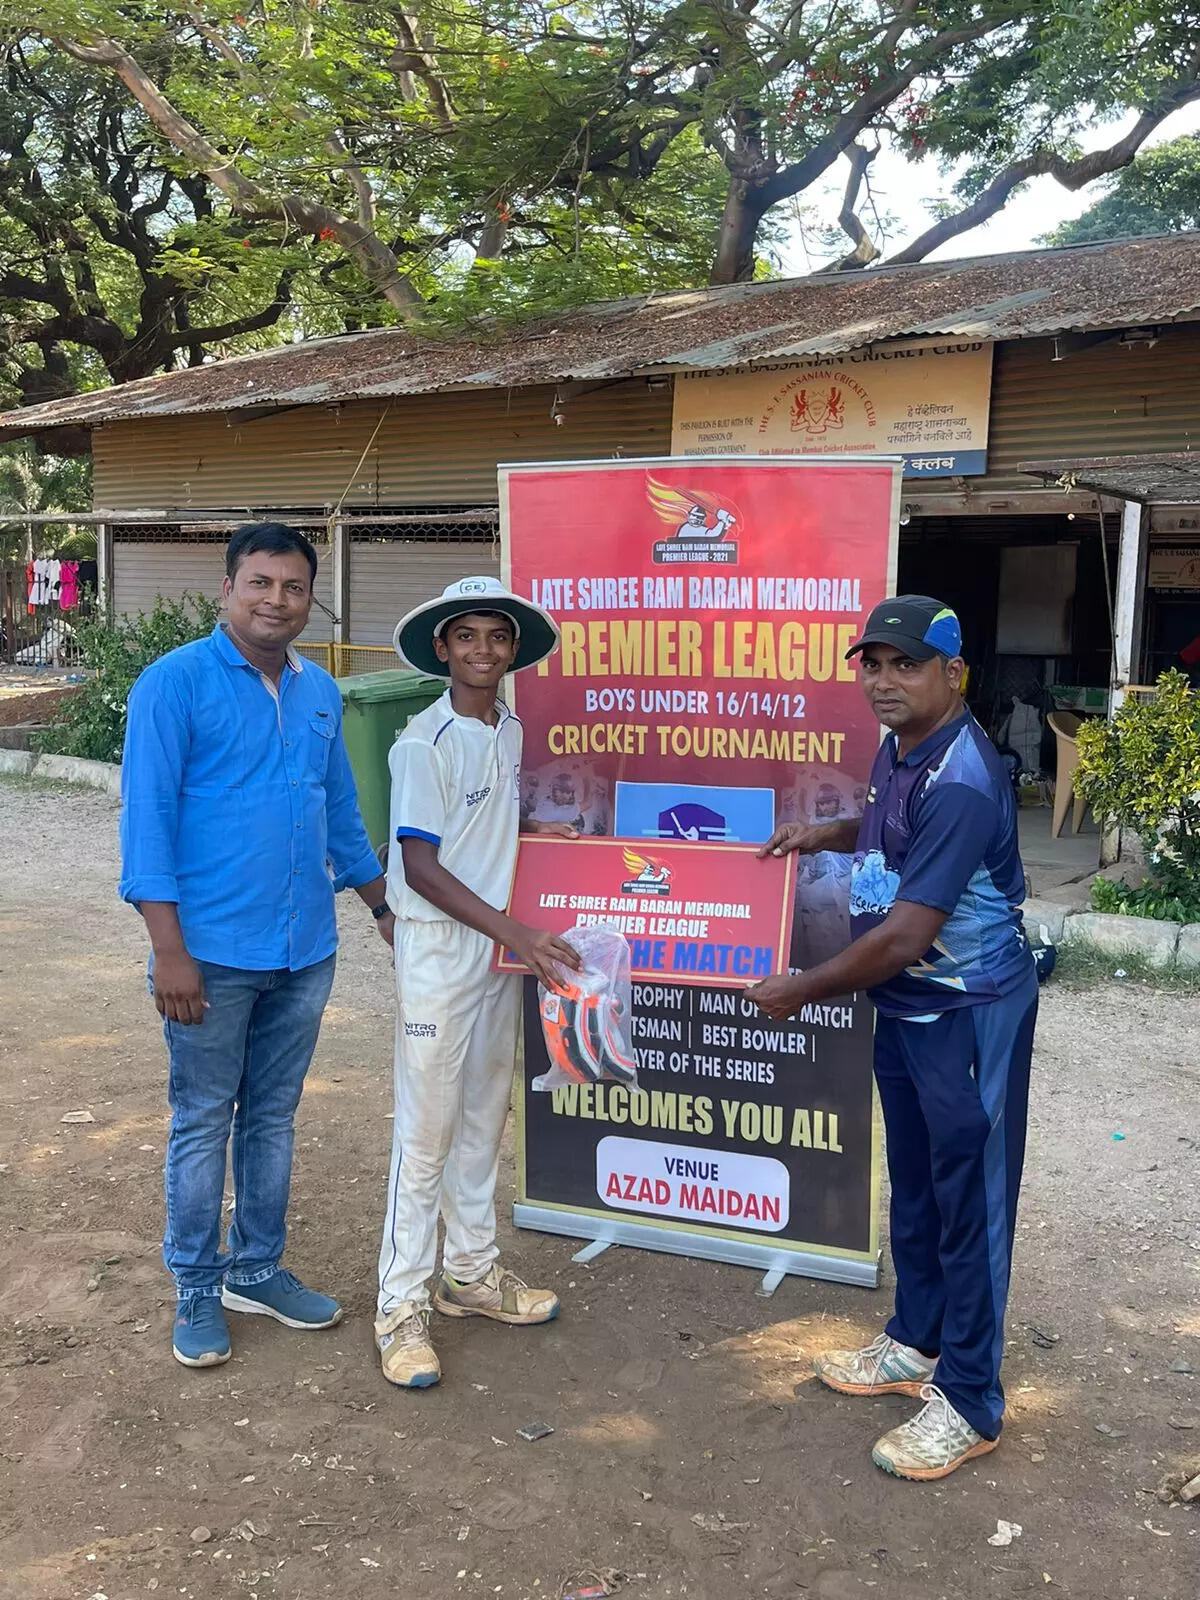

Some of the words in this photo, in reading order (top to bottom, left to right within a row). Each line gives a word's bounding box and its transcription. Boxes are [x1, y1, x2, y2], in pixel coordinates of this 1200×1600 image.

[759, 415, 770, 433] THE
[780, 370, 832, 396] SASSANIAN
[833, 371, 869, 400] CRICKET
[863, 400, 877, 428] CLUB
[911, 456, 956, 471] क्लब
[662, 552, 688, 561] PREMIER
[688, 552, 709, 561] LEAGUE
[713, 552, 728, 561] 2021
[532, 578, 573, 611] LATE
[578, 577, 639, 610] SHREE
[643, 577, 684, 609] RAM
[689, 577, 753, 610] BARAN
[757, 576, 862, 612] MEMORIAL
[713, 620, 857, 683] LEAGUE
[585, 688, 635, 713] BOYS
[641, 689, 708, 715] UNDER
[715, 691, 806, 719] 16/14/12
[547, 723, 648, 755] CRICKET
[656, 725, 846, 764] TOURNAMENT
[539, 893, 567, 910] LATE
[568, 894, 607, 911] SHREE
[609, 896, 637, 912] RAM
[640, 898, 682, 915] BARAN
[684, 901, 751, 919] MEMORIAL
[648, 916, 709, 938] LEAGUE
[674, 941, 773, 976] MATCH
[405, 1022, 437, 1031] NITRO
[699, 991, 736, 1016] MAN
[800, 1003, 853, 1029] MATCH
[631, 1017, 682, 1042] TSMAN
[703, 1024, 737, 1048] BEST
[742, 1028, 806, 1055] BOWLER
[632, 1049, 666, 1072] AYER
[669, 1052, 690, 1073] OF
[693, 1054, 723, 1078] THE
[726, 1058, 775, 1085] SERIES
[550, 1082, 713, 1136] WELCOMES
[720, 1100, 784, 1146] YOU
[790, 1108, 844, 1154] ALL
[664, 1156, 719, 1182] VENUE
[605, 1172, 671, 1207] AZAD
[679, 1184, 781, 1224] MAIDAN
